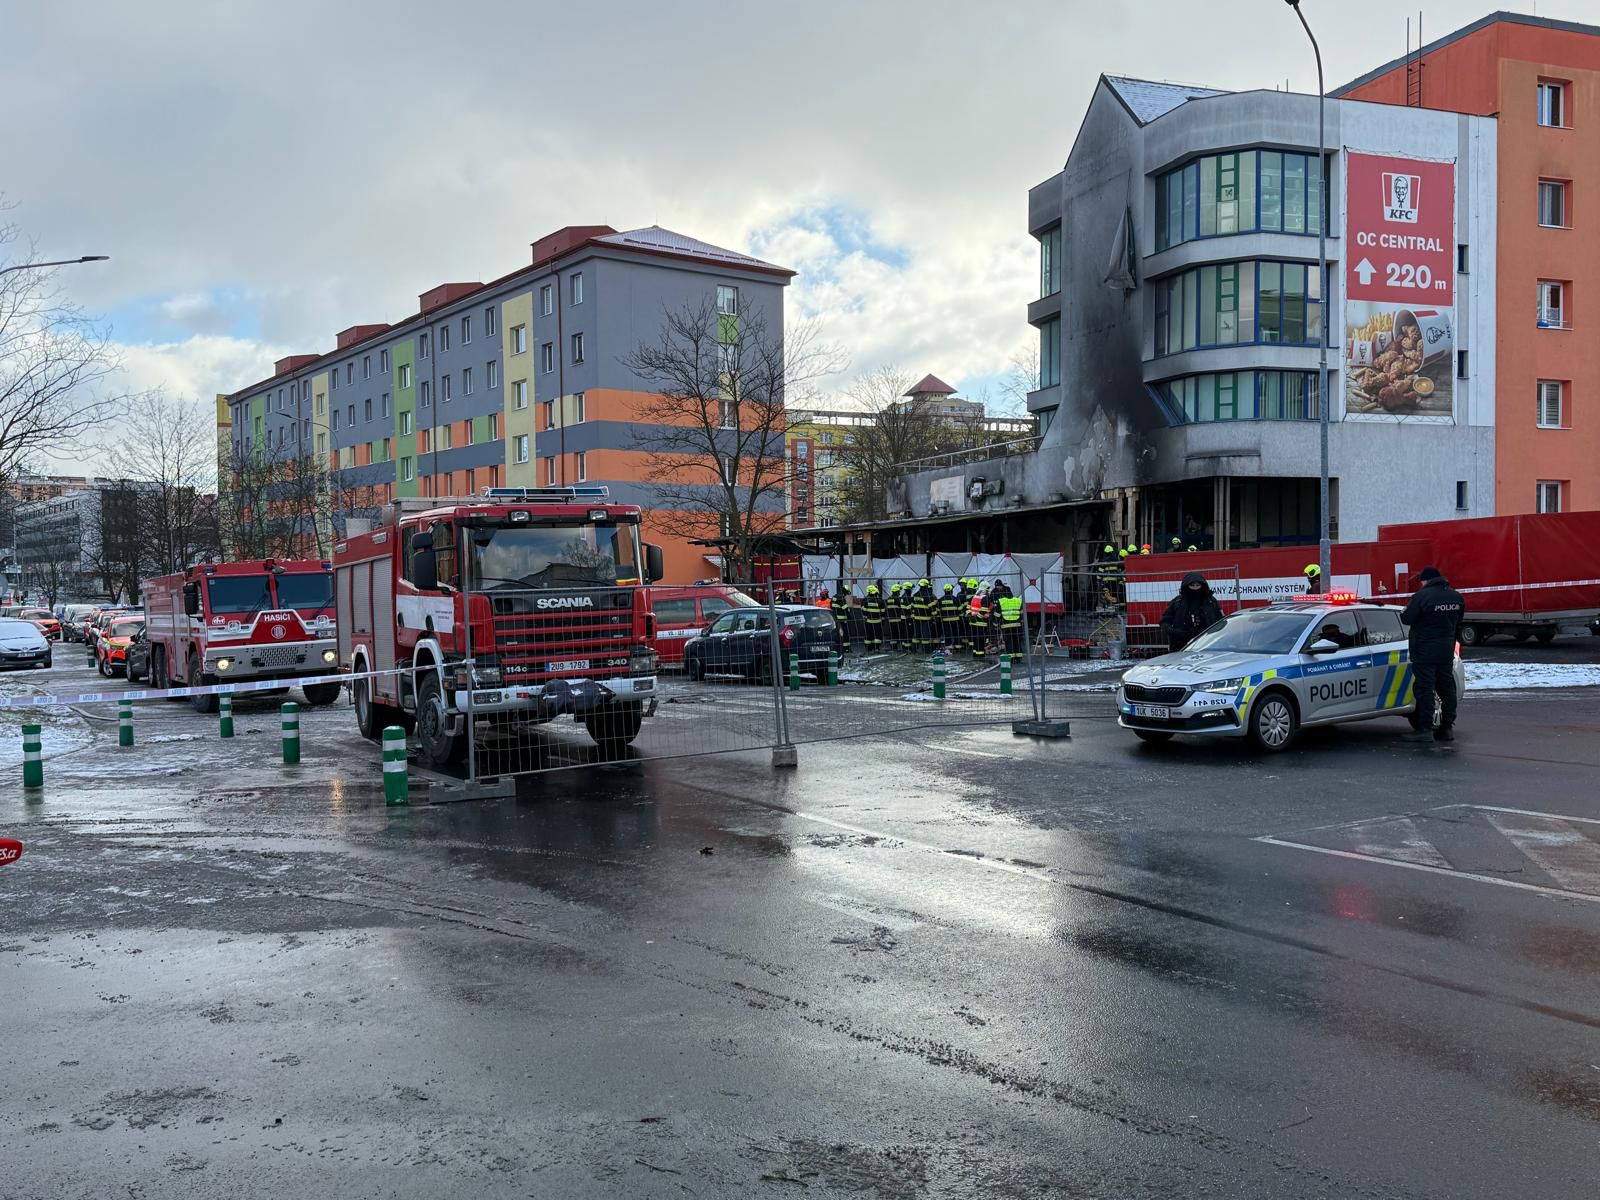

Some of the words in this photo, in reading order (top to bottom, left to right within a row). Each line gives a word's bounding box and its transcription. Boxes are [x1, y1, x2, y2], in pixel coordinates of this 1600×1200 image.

[1389, 209, 1413, 220] KFC
[1357, 231, 1377, 246] OC
[1380, 233, 1444, 252] CENTRAL
[1386, 262, 1432, 289] 220
[1434, 280, 1447, 290] m
[1274, 583, 1306, 593] SYSTÉM
[537, 597, 593, 609] SCANIA
[264, 613, 290, 621] HASIČI
[570, 661, 587, 669] 1792
[607, 658, 628, 666] 340
[1310, 679, 1367, 702] POLICIE
[1150, 708, 1167, 717] 5036
